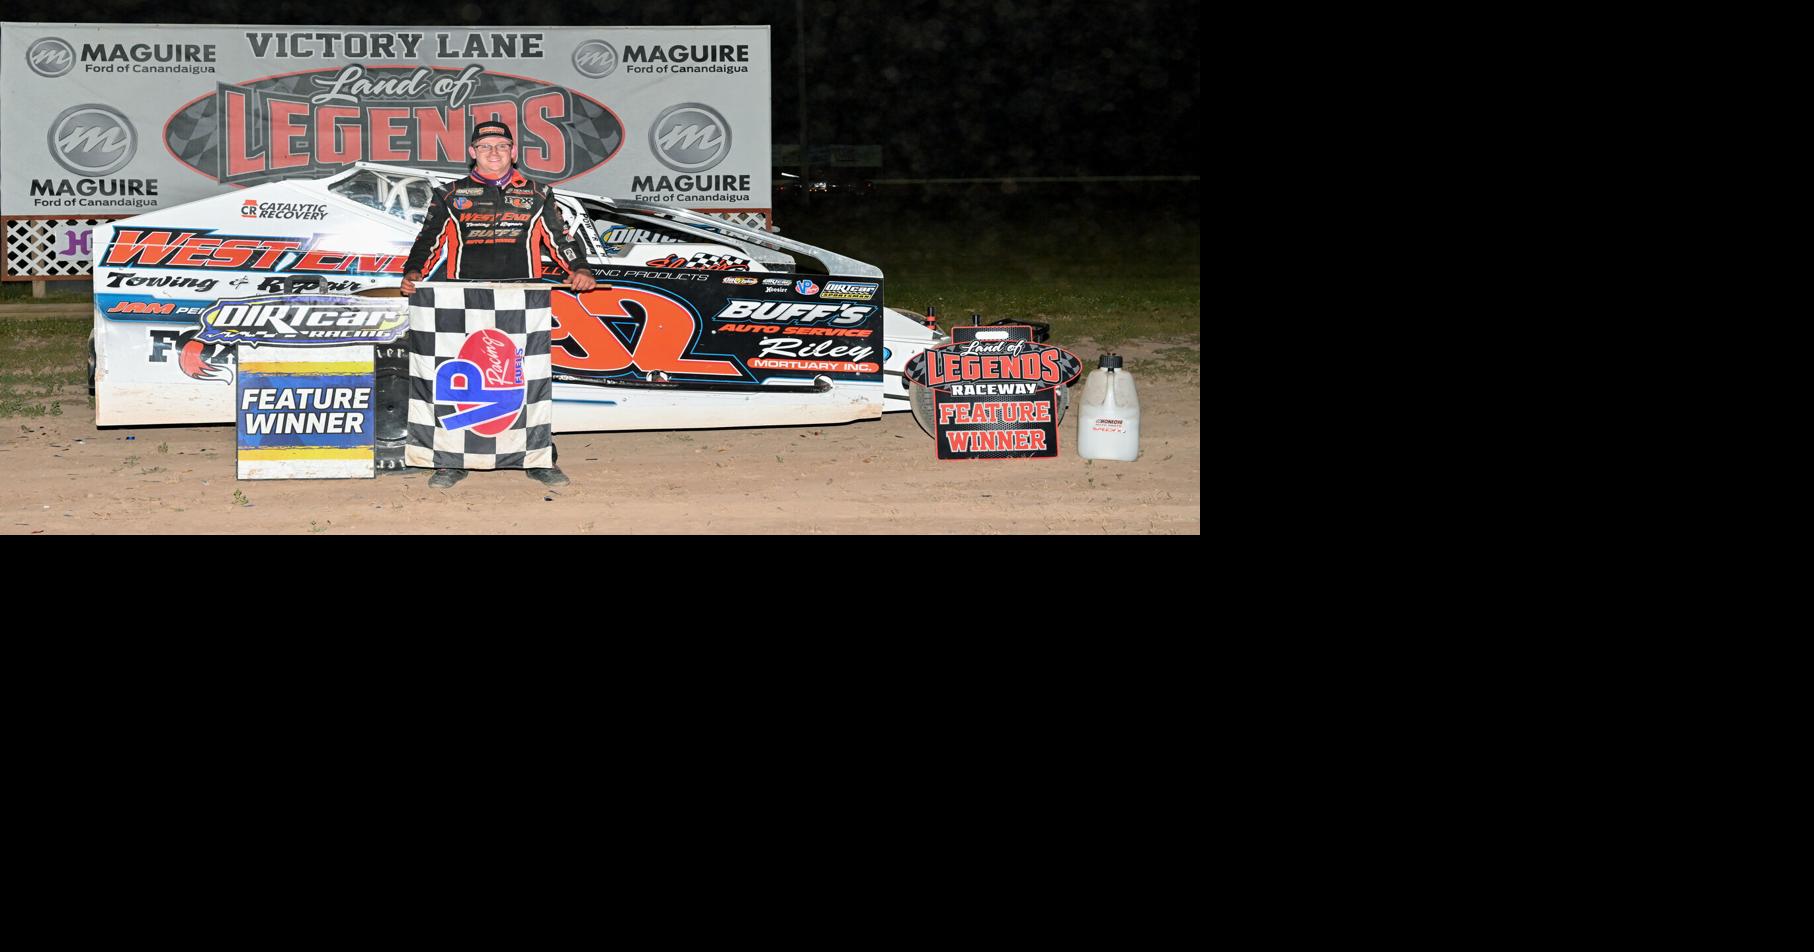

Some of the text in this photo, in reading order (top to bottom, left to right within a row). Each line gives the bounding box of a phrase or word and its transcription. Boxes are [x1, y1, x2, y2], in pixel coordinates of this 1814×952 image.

[80, 43, 217, 64] MAGUIRE
[247, 32, 544, 59] VICTORY LANE
[622, 44, 749, 64] MAGUIRE
[85, 63, 216, 75] Ford of Canandaigua
[627, 64, 749, 76] Ford of Canandaigua
[312, 65, 482, 107] Land of
[30, 178, 158, 198] MAGUIRE
[631, 174, 750, 193] MAGUIRE
[34, 198, 158, 209] Ford of Canandaigua
[259, 202, 327, 213] CATALYTIC
[635, 193, 750, 204] Ford of Canandaigua
[241, 205, 257, 215] CR
[259, 210, 328, 221] RECOVERY
[503, 212, 530, 222] END
[106, 230, 301, 269] WEST
[107, 272, 219, 292] Towing
[624, 270, 709, 281] PRODUCTS
[108, 302, 176, 314] JAM
[717, 300, 872, 325] BUFF'S
[212, 304, 402, 336] DIRTcar
[718, 324, 873, 337] AUTO SERVICE
[485, 329, 514, 385] Racing
[758, 338, 874, 363] Riley
[960, 339, 1025, 356] Land of
[514, 348, 524, 384] FUELS
[754, 359, 873, 372] MORTUARY INC.
[926, 349, 1060, 386] LEGENDS
[242, 388, 371, 410] FEATURE
[436, 360, 525, 430] VP
[952, 383, 1036, 396] RACEWAY
[939, 401, 1051, 425] FEATURE
[245, 412, 364, 435] WINNER
[946, 429, 1047, 452] WINNER
